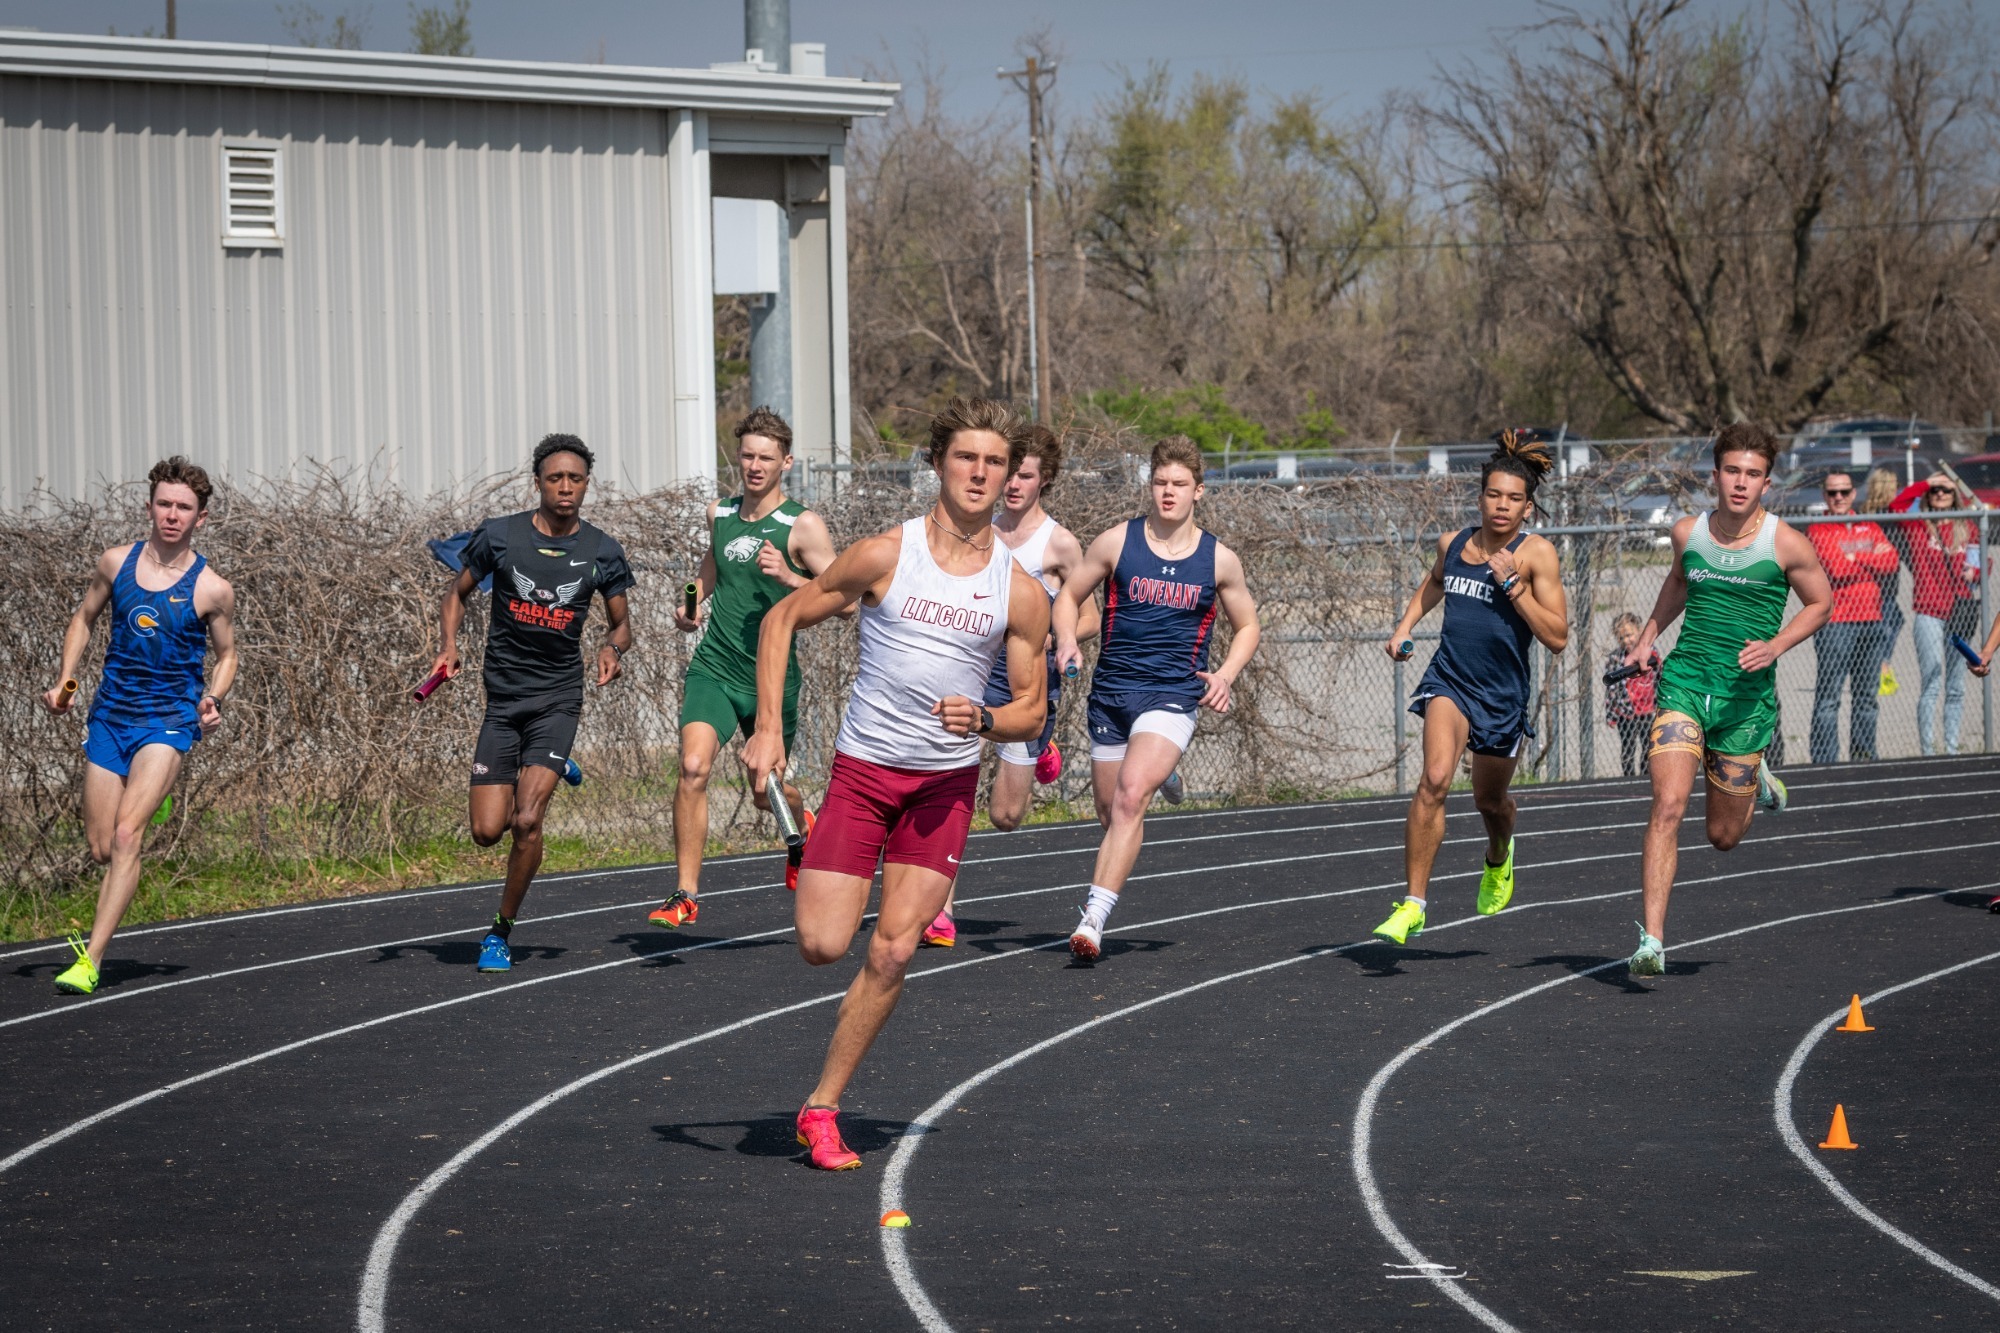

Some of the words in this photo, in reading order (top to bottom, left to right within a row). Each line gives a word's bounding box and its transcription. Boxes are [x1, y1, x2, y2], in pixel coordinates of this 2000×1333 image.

[1128, 575, 1202, 611] COVENANT
[1443, 575, 1495, 604] HAWNEE
[509, 599, 575, 623] EAGLES
[514, 613, 537, 625] TRACK
[539, 619, 545, 627] &
[547, 620, 567, 630] FIELD
[900, 596, 994, 638] LINCOLN
